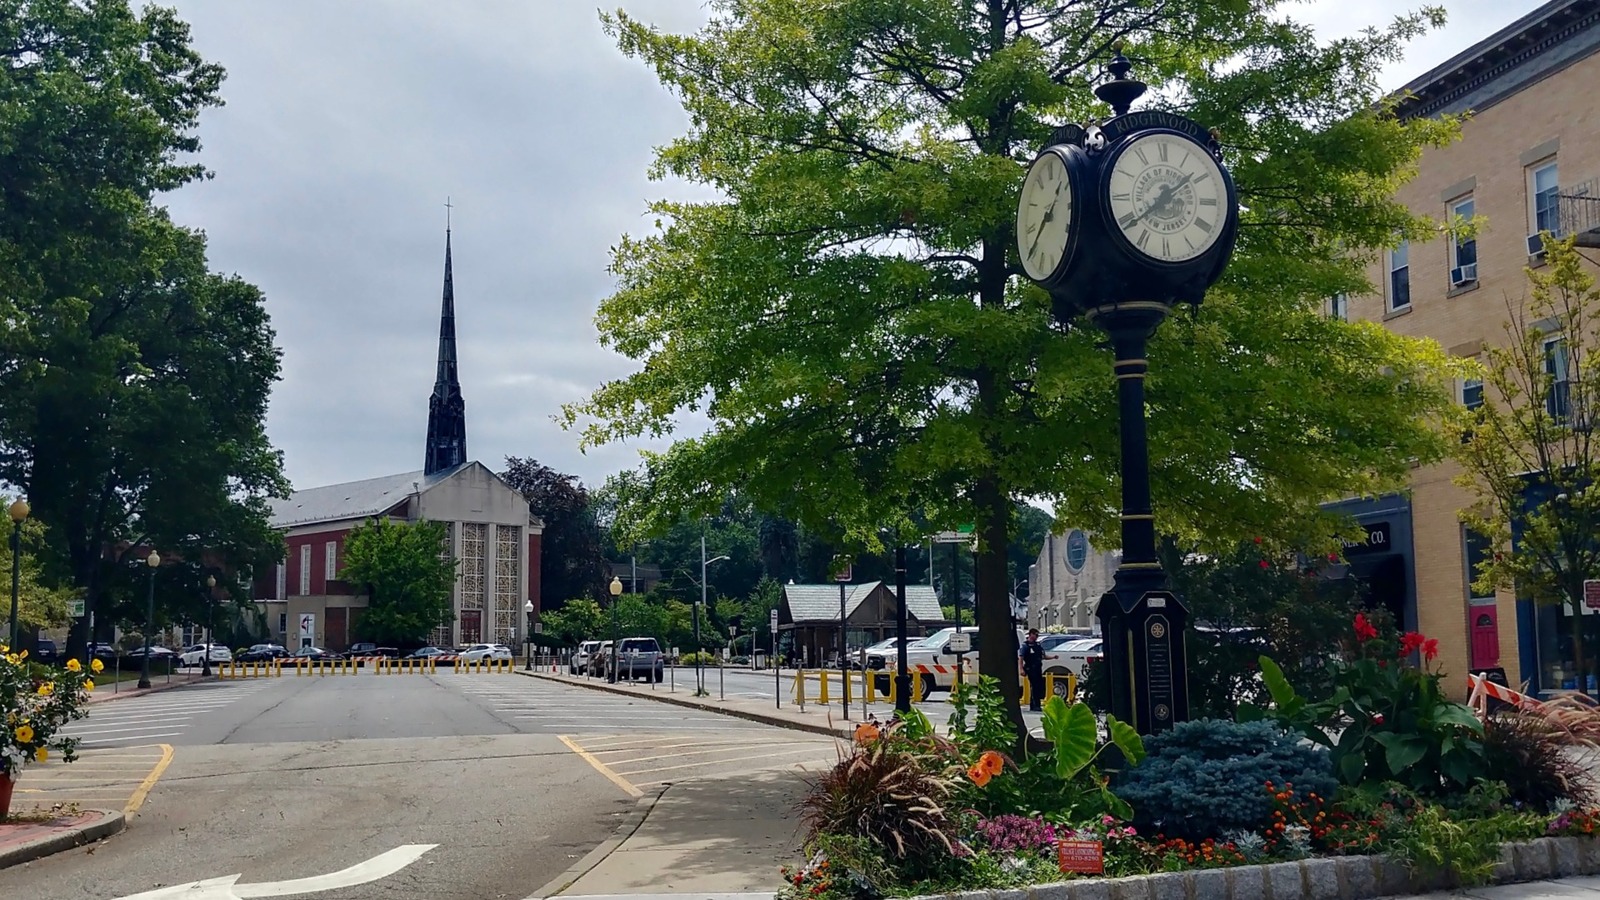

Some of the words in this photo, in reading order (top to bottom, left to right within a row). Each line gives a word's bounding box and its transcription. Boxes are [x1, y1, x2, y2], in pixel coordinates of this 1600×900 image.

[1116, 113, 1198, 136] RIDGEWOOD
[1135, 171, 1154, 202] VILLAGE
[1165, 169, 1193, 205] RIDGWOOD
[1162, 215, 1187, 231] JERSEY
